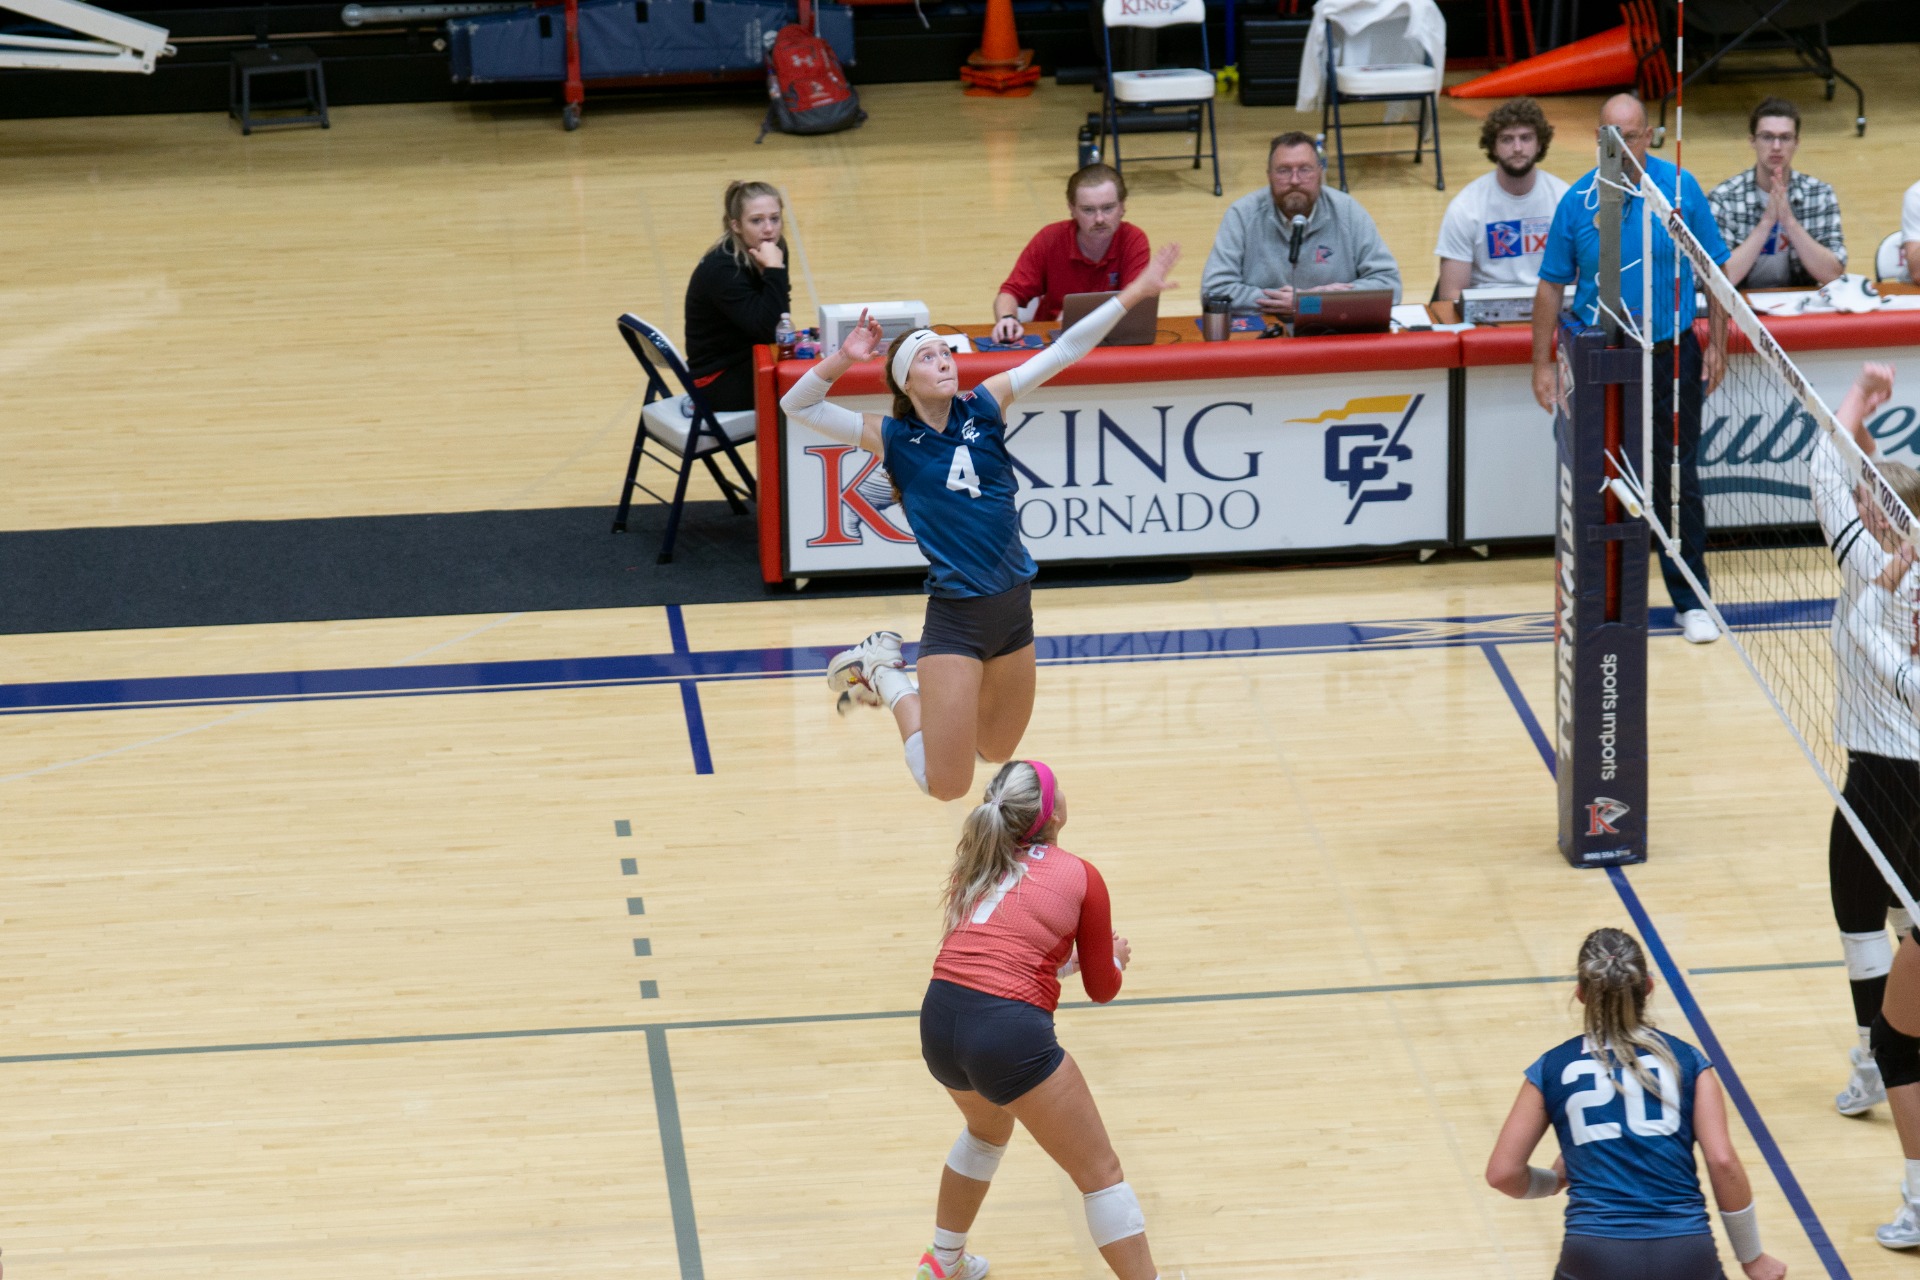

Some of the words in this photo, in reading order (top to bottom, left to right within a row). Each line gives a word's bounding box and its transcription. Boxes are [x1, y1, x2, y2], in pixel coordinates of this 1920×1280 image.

[1121, 0, 1170, 14] KING
[945, 444, 982, 499] 4
[1017, 489, 1261, 539] ORNADO
[1558, 462, 1574, 761] TORNADO
[1600, 653, 1618, 710] sports
[1599, 713, 1617, 780] imports
[1561, 1054, 1681, 1146] 20
